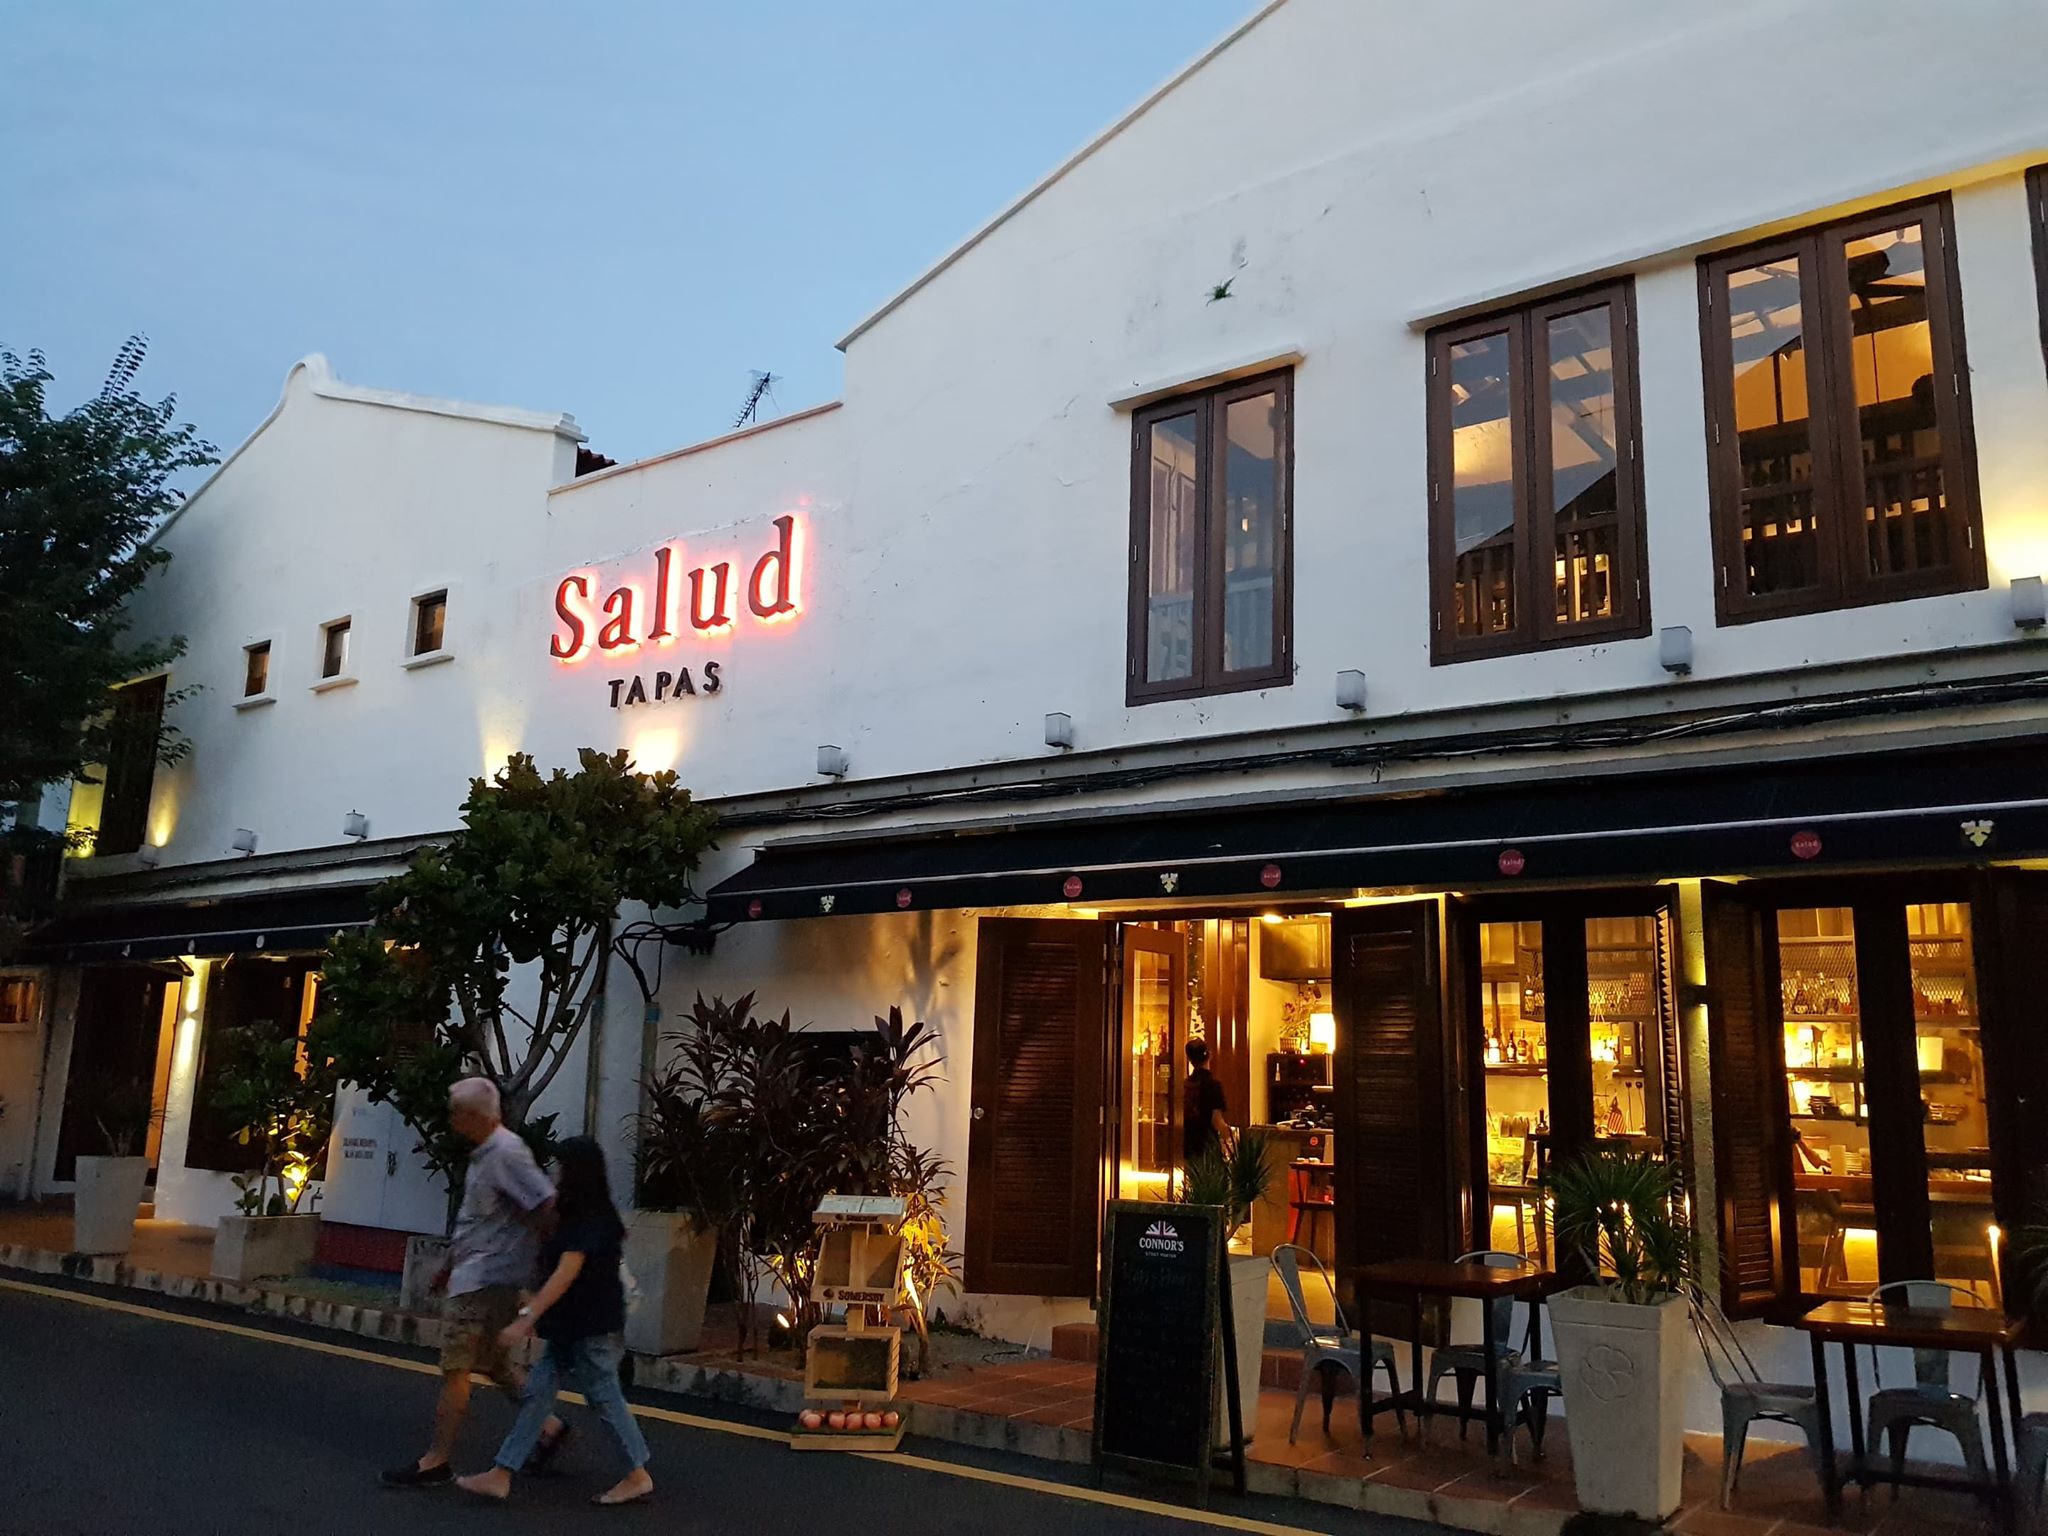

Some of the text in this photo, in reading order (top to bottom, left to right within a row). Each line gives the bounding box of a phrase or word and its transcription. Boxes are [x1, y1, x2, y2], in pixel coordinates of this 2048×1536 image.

[549, 514, 796, 660] Salud
[607, 661, 720, 708] TAPAS
[1139, 1237, 1184, 1252] CONNOR'S
